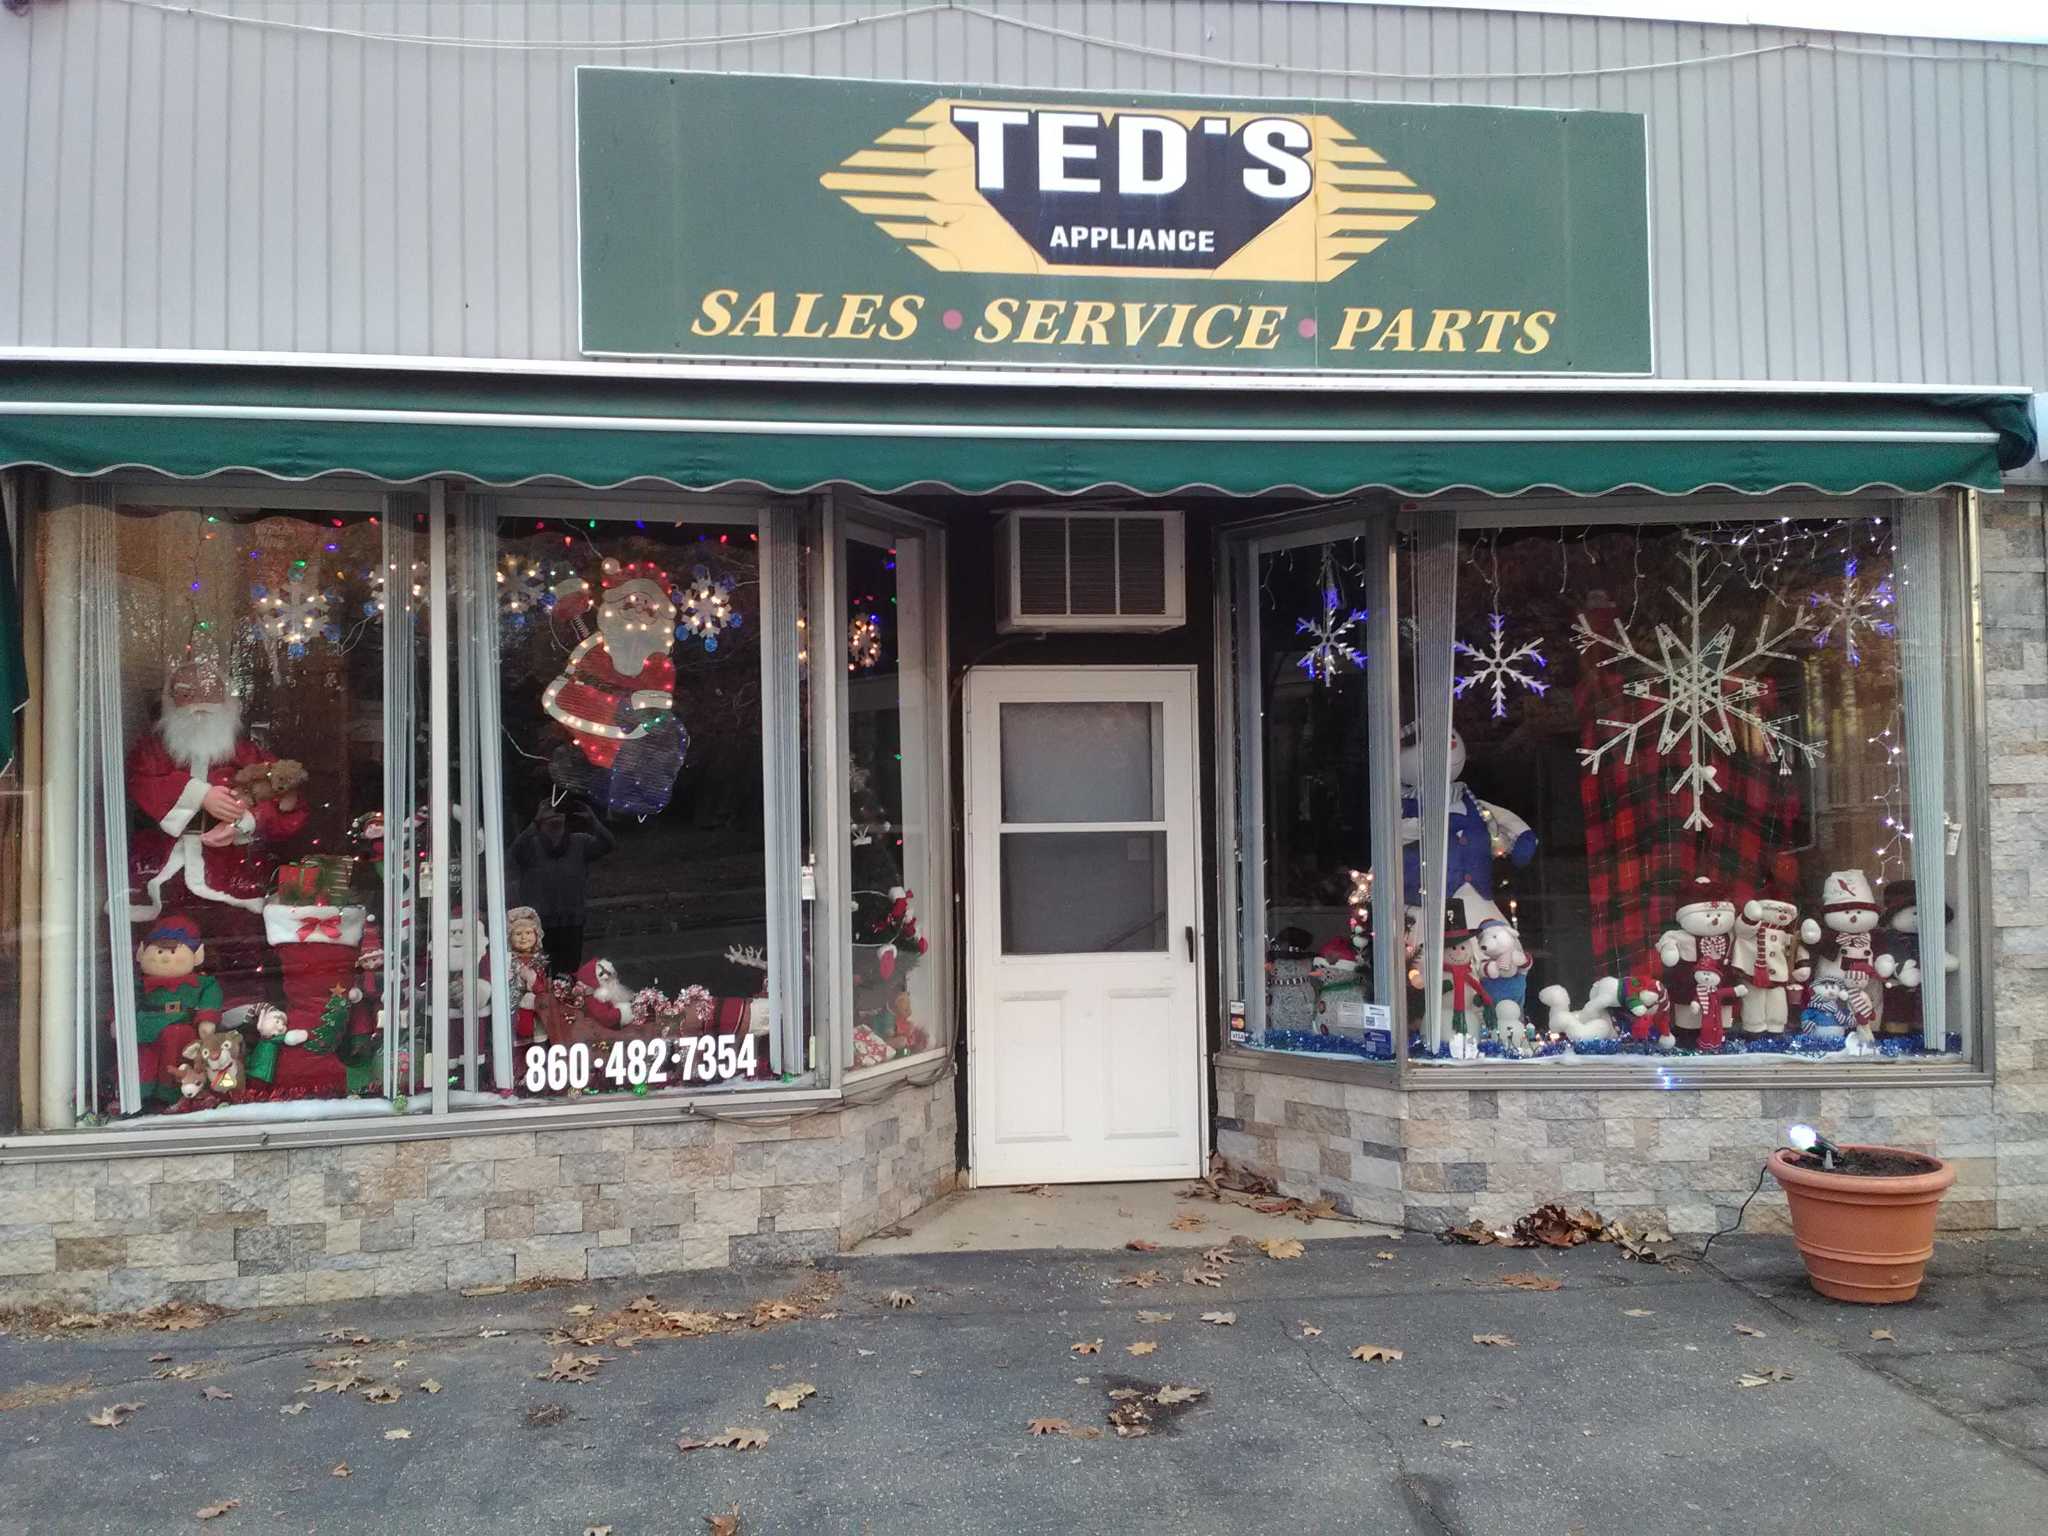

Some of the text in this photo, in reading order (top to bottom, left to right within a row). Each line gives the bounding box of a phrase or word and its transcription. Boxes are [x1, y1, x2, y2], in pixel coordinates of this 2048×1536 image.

[953, 107, 1313, 200] TED'S
[1050, 225, 1216, 253] APPLIANCE
[691, 289, 1557, 355] SALES SERVICE PARTS
